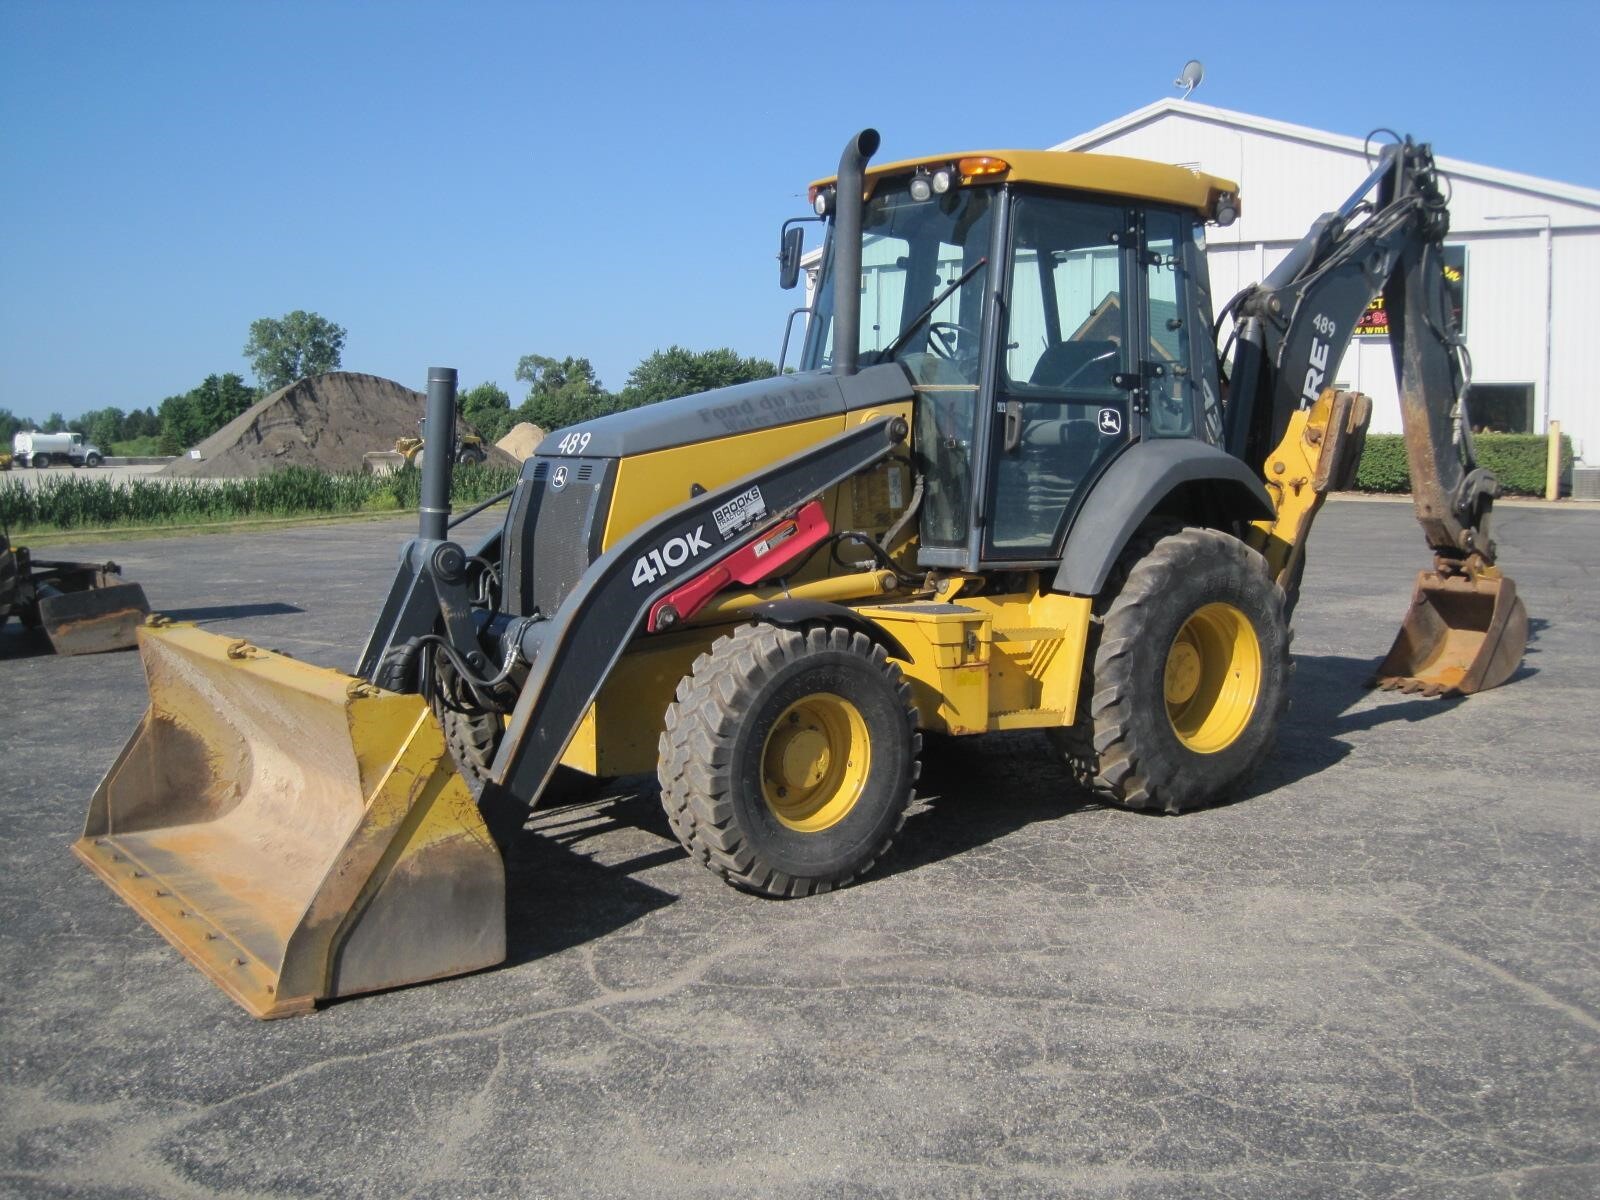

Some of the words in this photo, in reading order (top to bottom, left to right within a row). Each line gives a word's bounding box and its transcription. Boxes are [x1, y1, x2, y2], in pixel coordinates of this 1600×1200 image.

[1313, 313, 1336, 338] 489
[697, 398, 754, 423] Fond
[759, 393, 787, 410] du
[788, 385, 829, 403] Lac
[558, 432, 591, 455] 489
[715, 487, 760, 522] BROOKS
[631, 525, 712, 587] 410K
